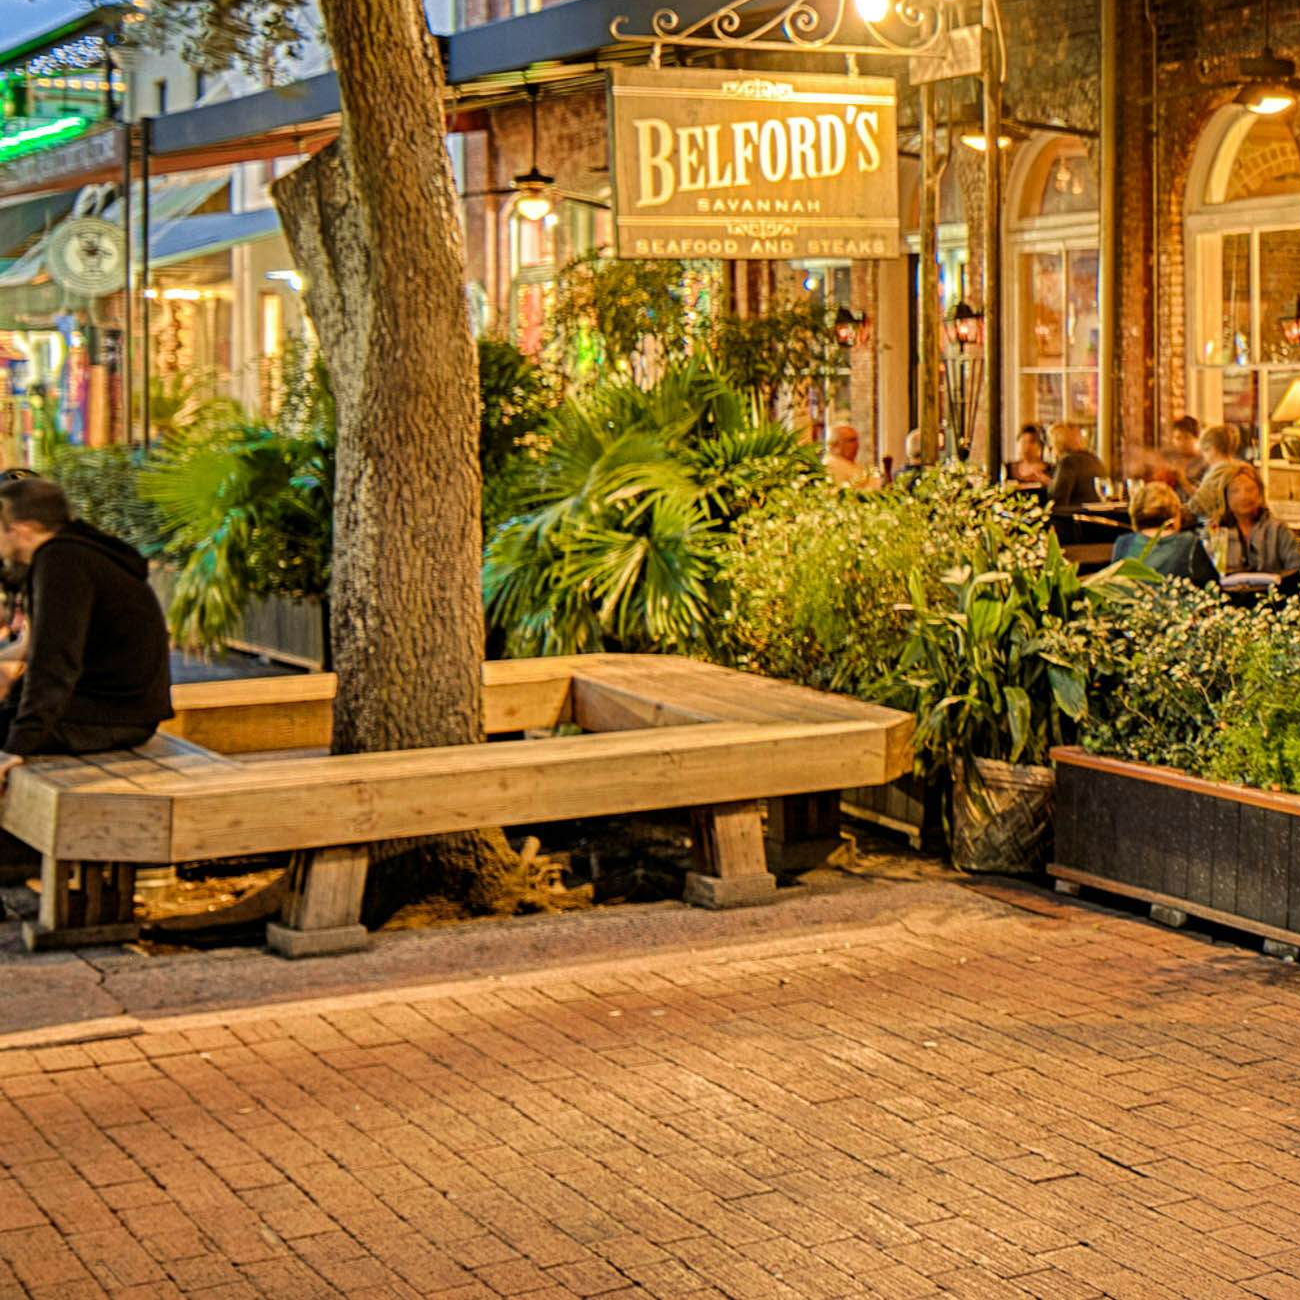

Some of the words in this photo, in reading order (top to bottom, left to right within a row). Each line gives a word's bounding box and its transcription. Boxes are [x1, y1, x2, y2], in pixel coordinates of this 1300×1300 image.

[632, 104, 881, 208] BELFORD'S
[696, 197, 821, 214] SAVANNAH
[634, 238, 739, 256] SEAFOOD
[750, 239, 794, 255] AND
[807, 238, 885, 255] STEAKS
